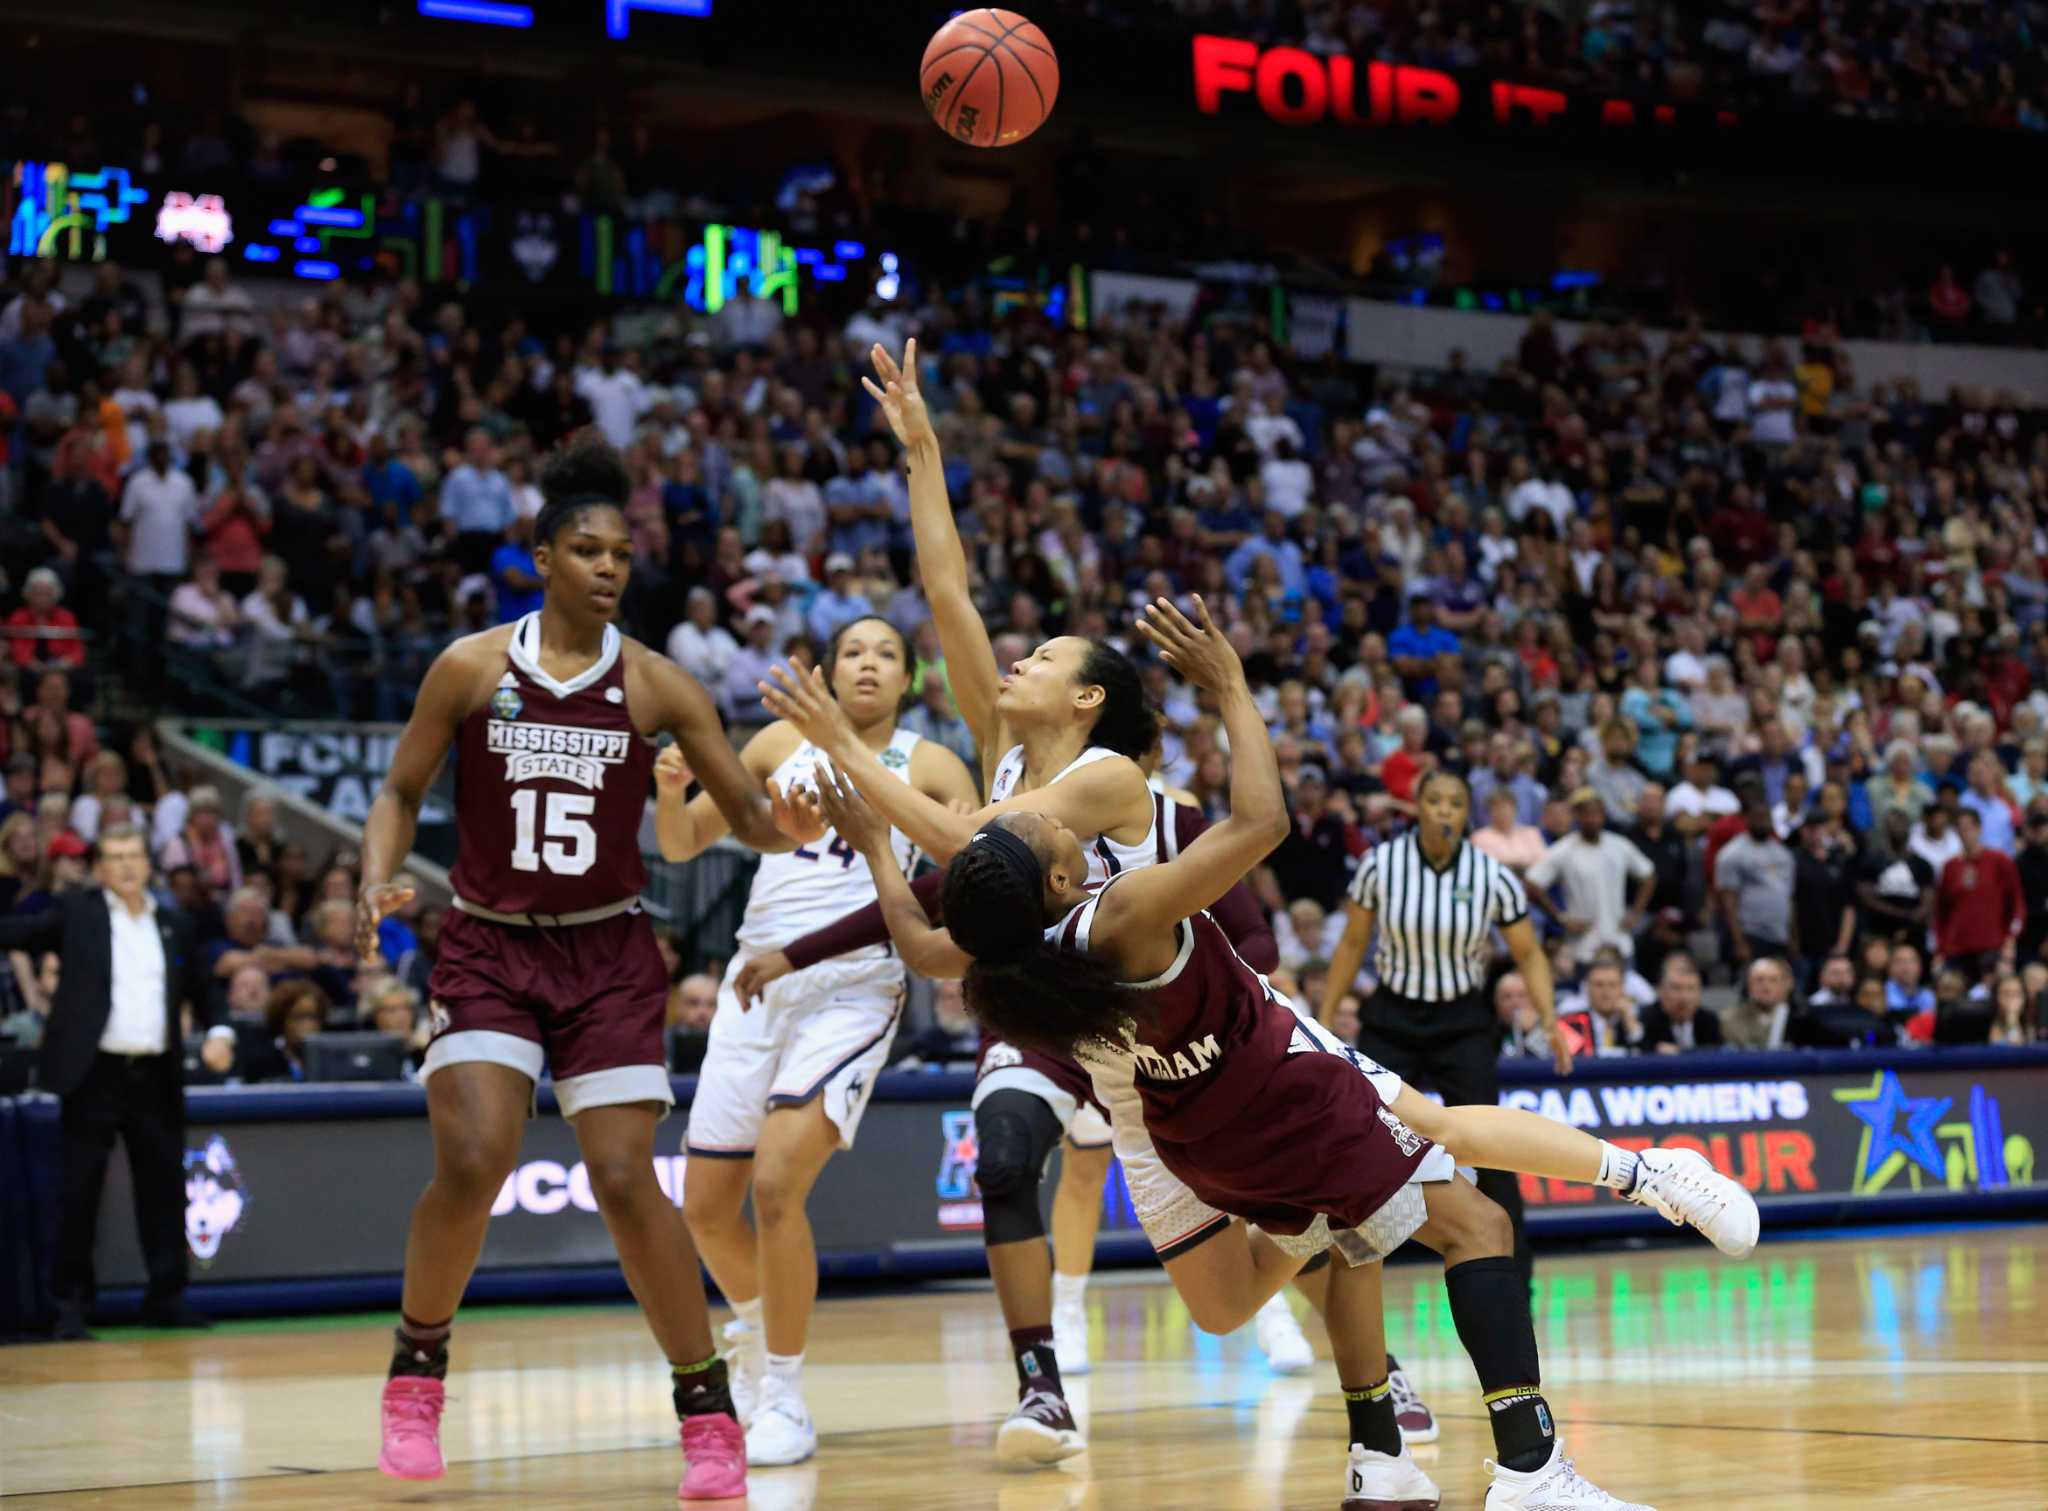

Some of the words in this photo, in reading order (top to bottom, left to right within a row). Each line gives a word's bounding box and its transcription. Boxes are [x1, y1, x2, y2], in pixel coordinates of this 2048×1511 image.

[487, 723, 630, 759] MISSISSIPPI
[521, 756, 588, 782] STATE
[510, 789, 598, 876] 15
[1601, 1080, 1809, 1127] WOMEN'S
